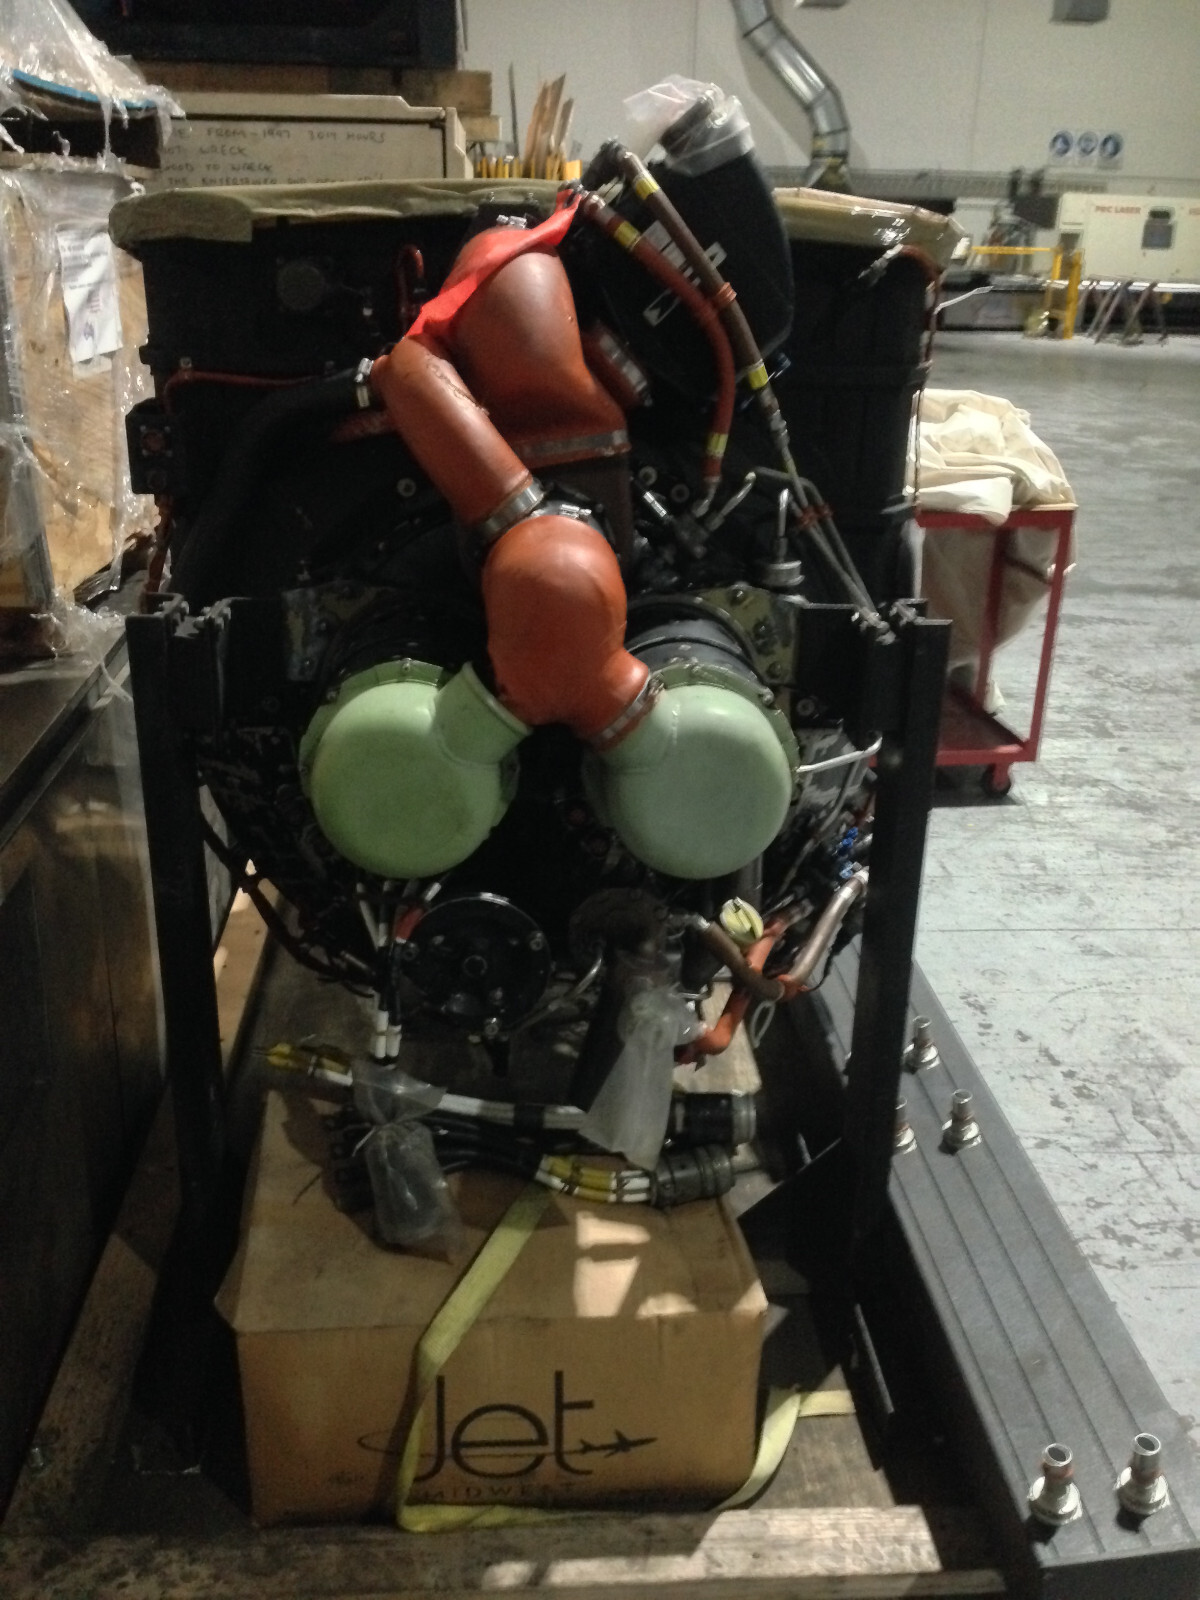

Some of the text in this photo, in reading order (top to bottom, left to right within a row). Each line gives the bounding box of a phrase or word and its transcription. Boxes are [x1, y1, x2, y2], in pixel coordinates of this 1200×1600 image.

[345, 129, 386, 144] HOURS
[199, 143, 248, 157] WRECK
[412, 1369, 595, 1482] Jet
